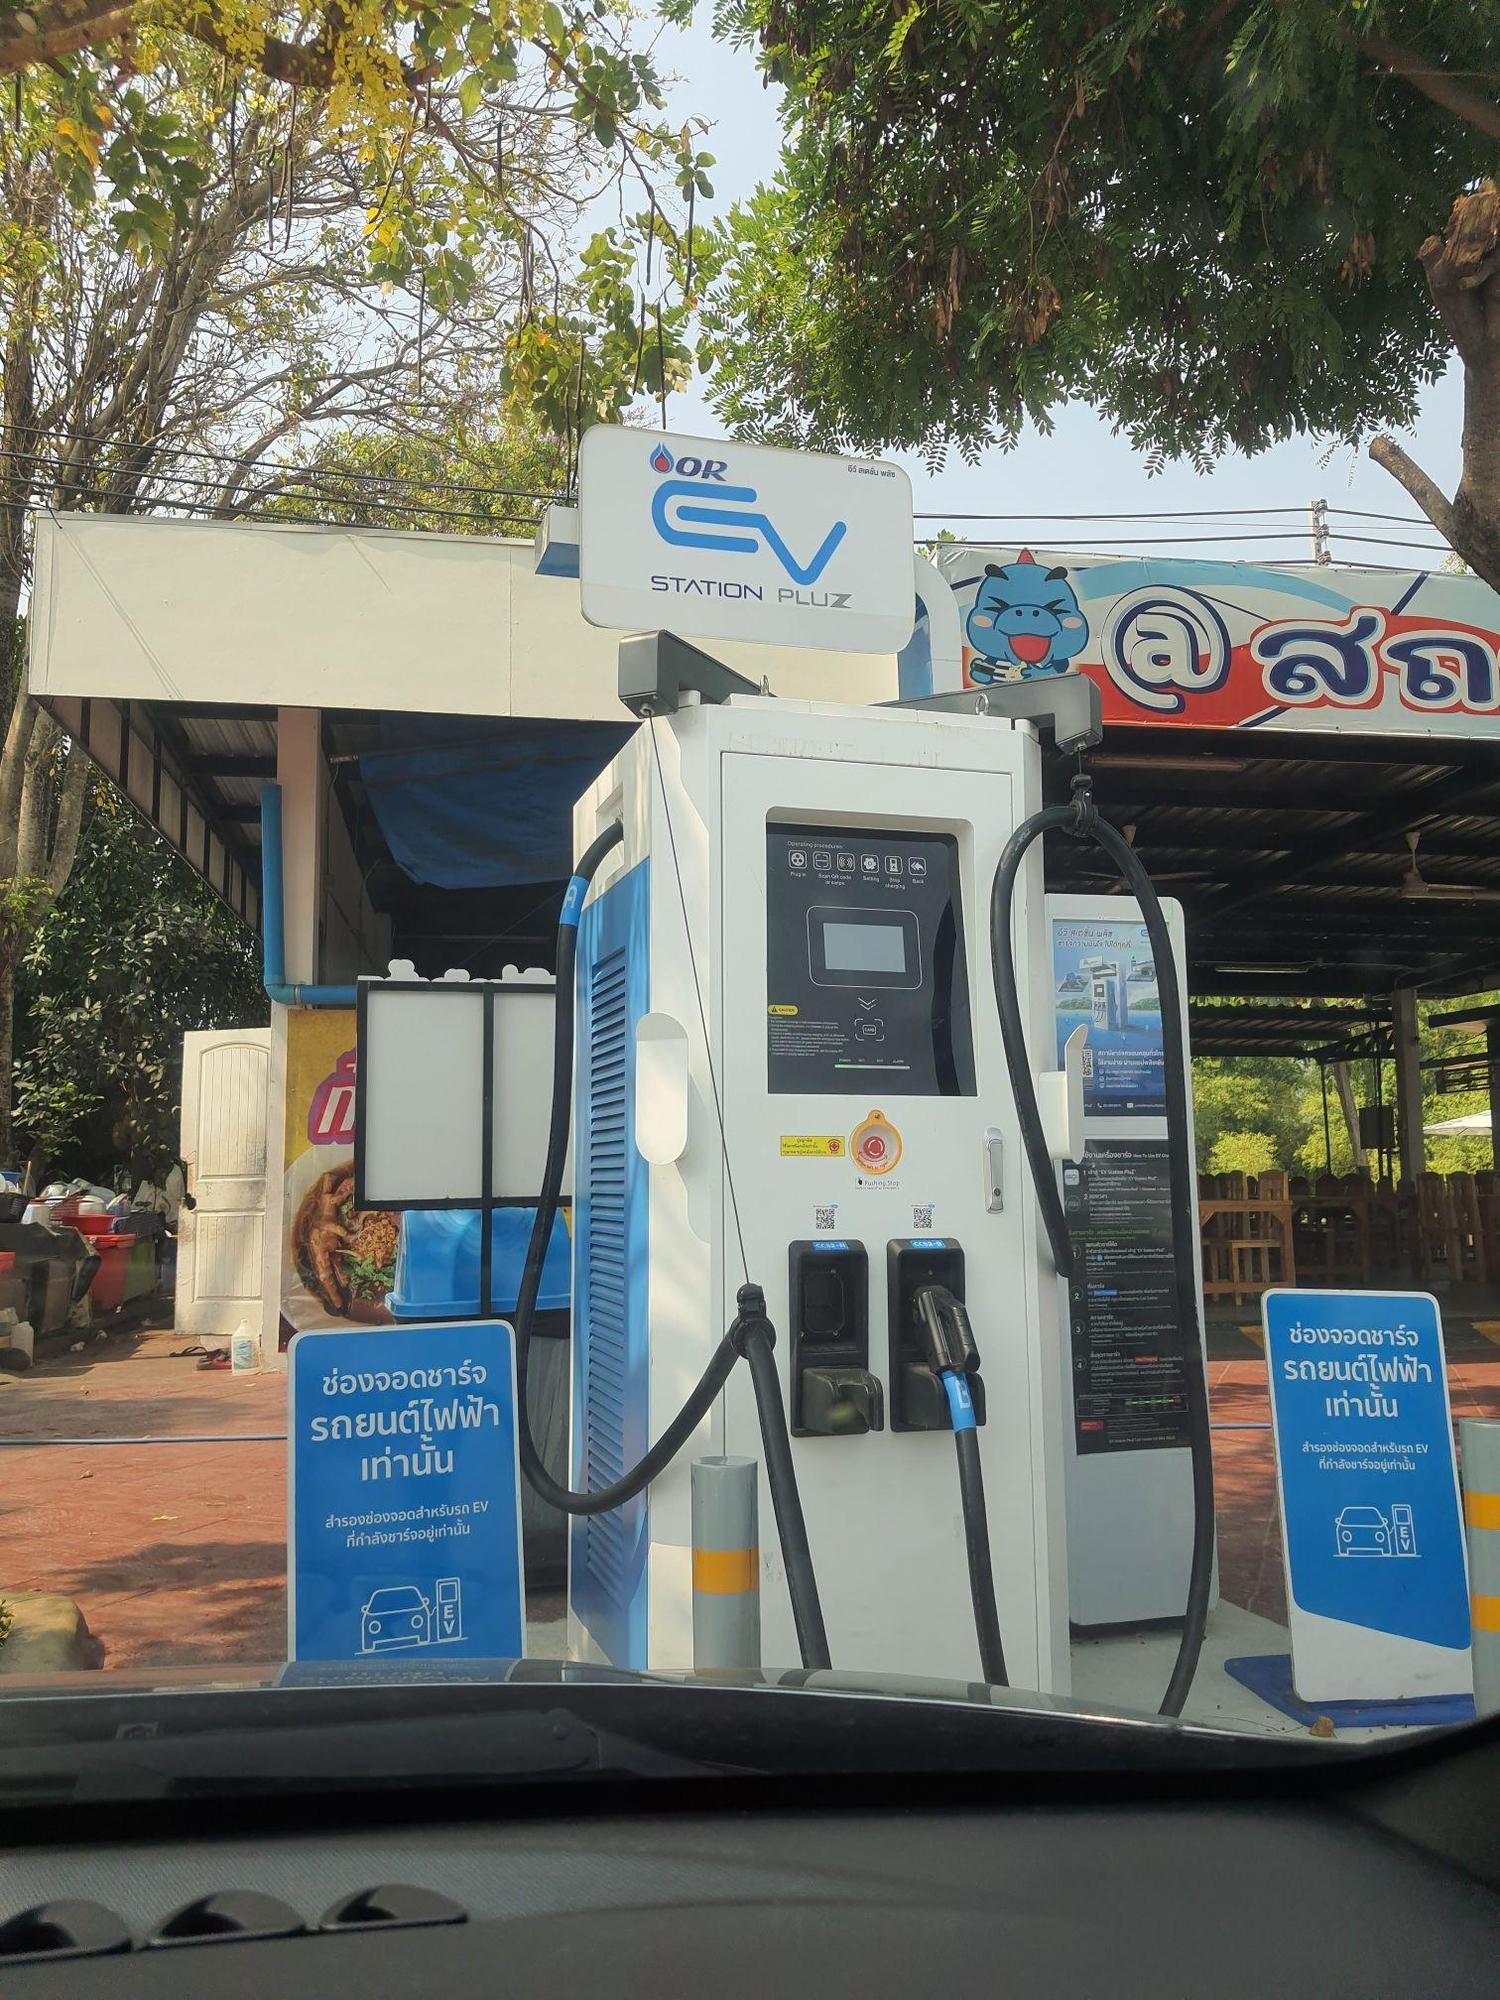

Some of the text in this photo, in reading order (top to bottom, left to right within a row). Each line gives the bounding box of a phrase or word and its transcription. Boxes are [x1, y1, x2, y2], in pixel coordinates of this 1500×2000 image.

[676, 456, 728, 481] OR
[651, 480, 847, 586] EV
[651, 576, 852, 609] STATION PLUZ
[864, 1179, 885, 1188] Pushing
[1290, 1322, 1419, 1346] ช่องจอดชาร์จ
[322, 1359, 487, 1395] ช่องจอดชาร์จ
[1284, 1354, 1432, 1383] รถยนต์ไฟฟ้า
[1326, 1385, 1399, 1418] เท่านั้น
[311, 1395, 499, 1441] รถยนต์ไฟฟ้า
[361, 1434, 454, 1480] เท่านั้น
[1302, 1441, 1428, 1453] สำรองช่องจอดสำหรับรถ EV
[1319, 1456, 1416, 1473] ที่กำลังชาร์จอยู่เท่านั้น
[325, 1501, 488, 1529] สำรองช่องจอดสำหรับรถ EV
[346, 1518, 470, 1548] ที่กำลังชาร์จอยู่เท่านั้น
